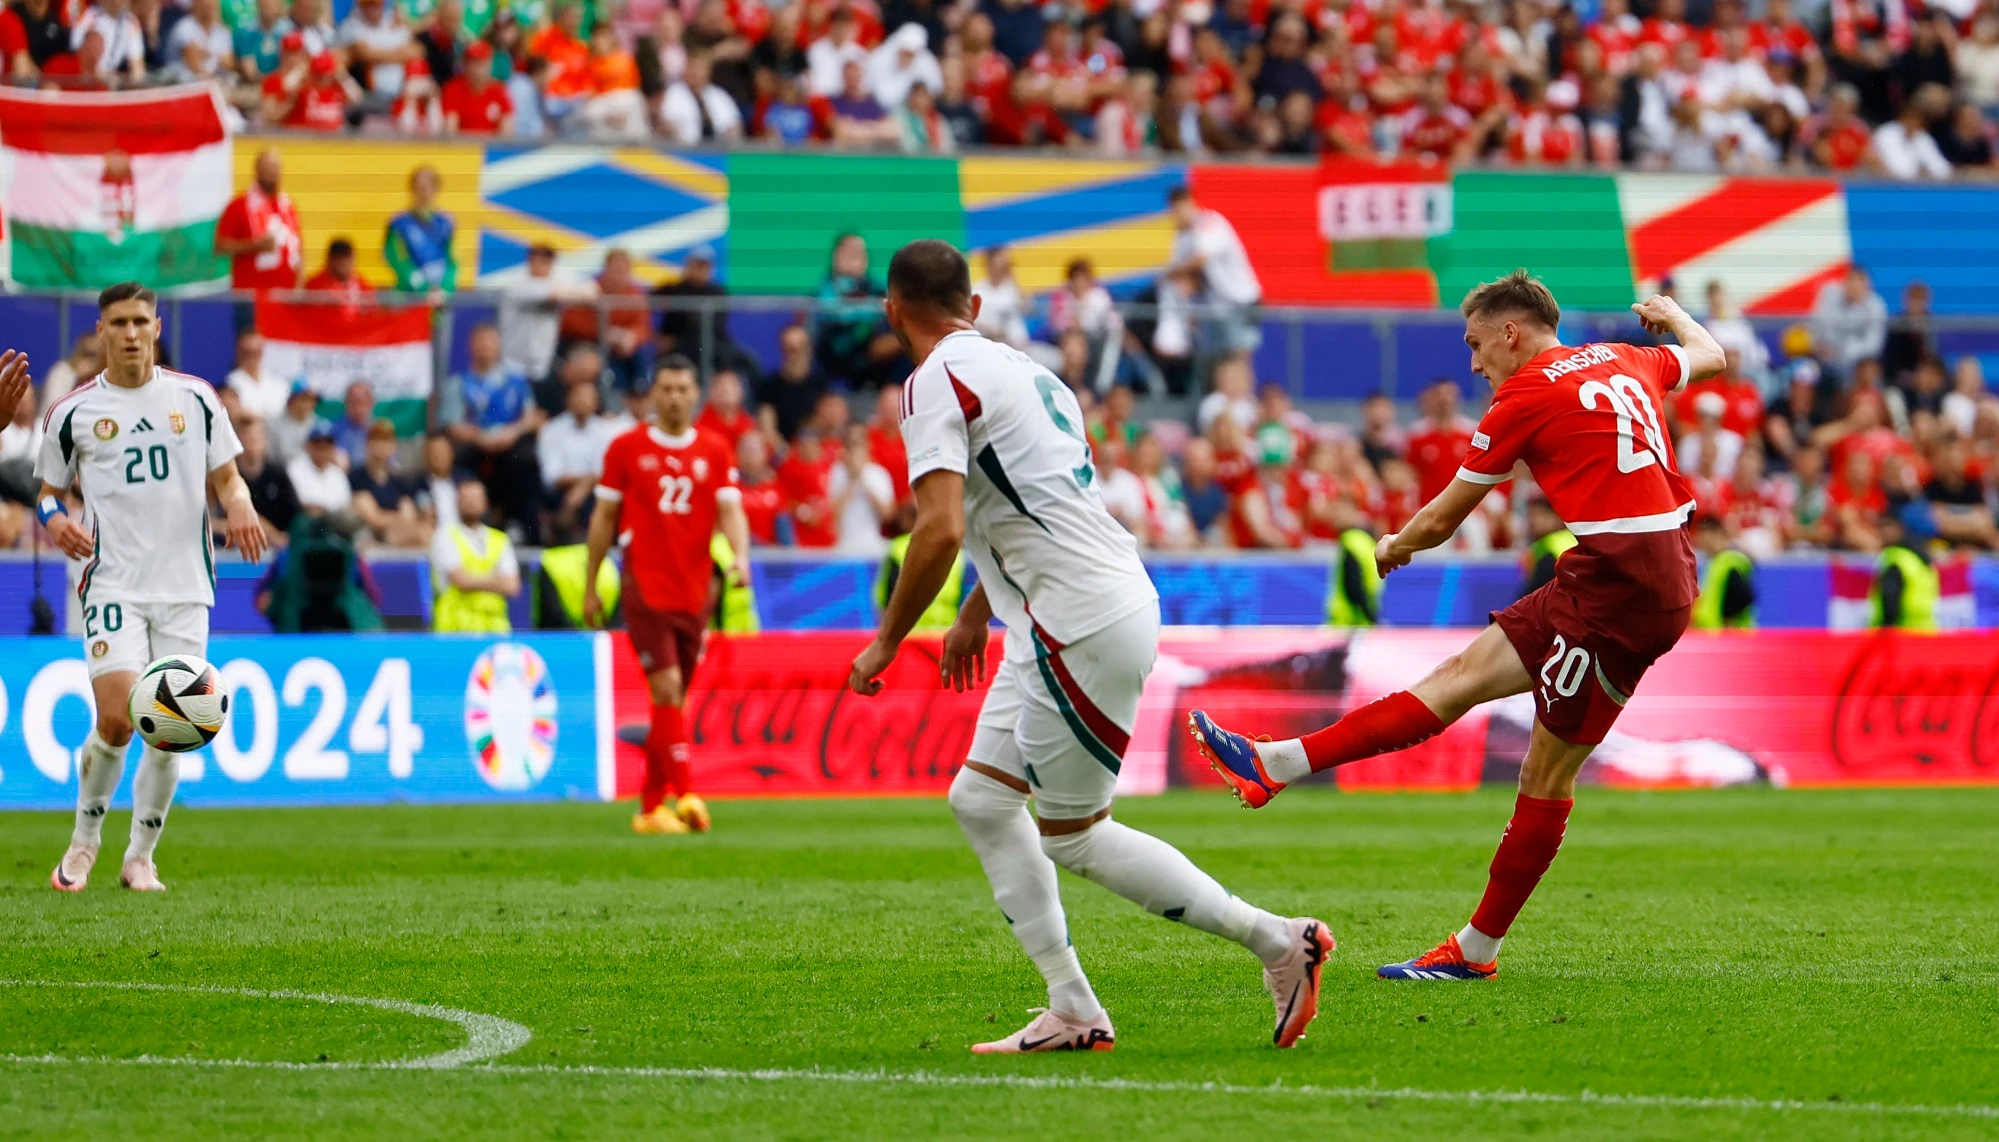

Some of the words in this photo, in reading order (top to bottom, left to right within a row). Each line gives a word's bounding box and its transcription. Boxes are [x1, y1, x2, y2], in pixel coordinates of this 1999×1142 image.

[1034, 374, 1093, 488] 9
[1578, 373, 1669, 474] 20
[124, 444, 170, 484] 20
[658, 474, 693, 515] 22
[83, 603, 122, 639] 20
[1540, 633, 1590, 698] 20
[178, 657, 424, 782] 024
